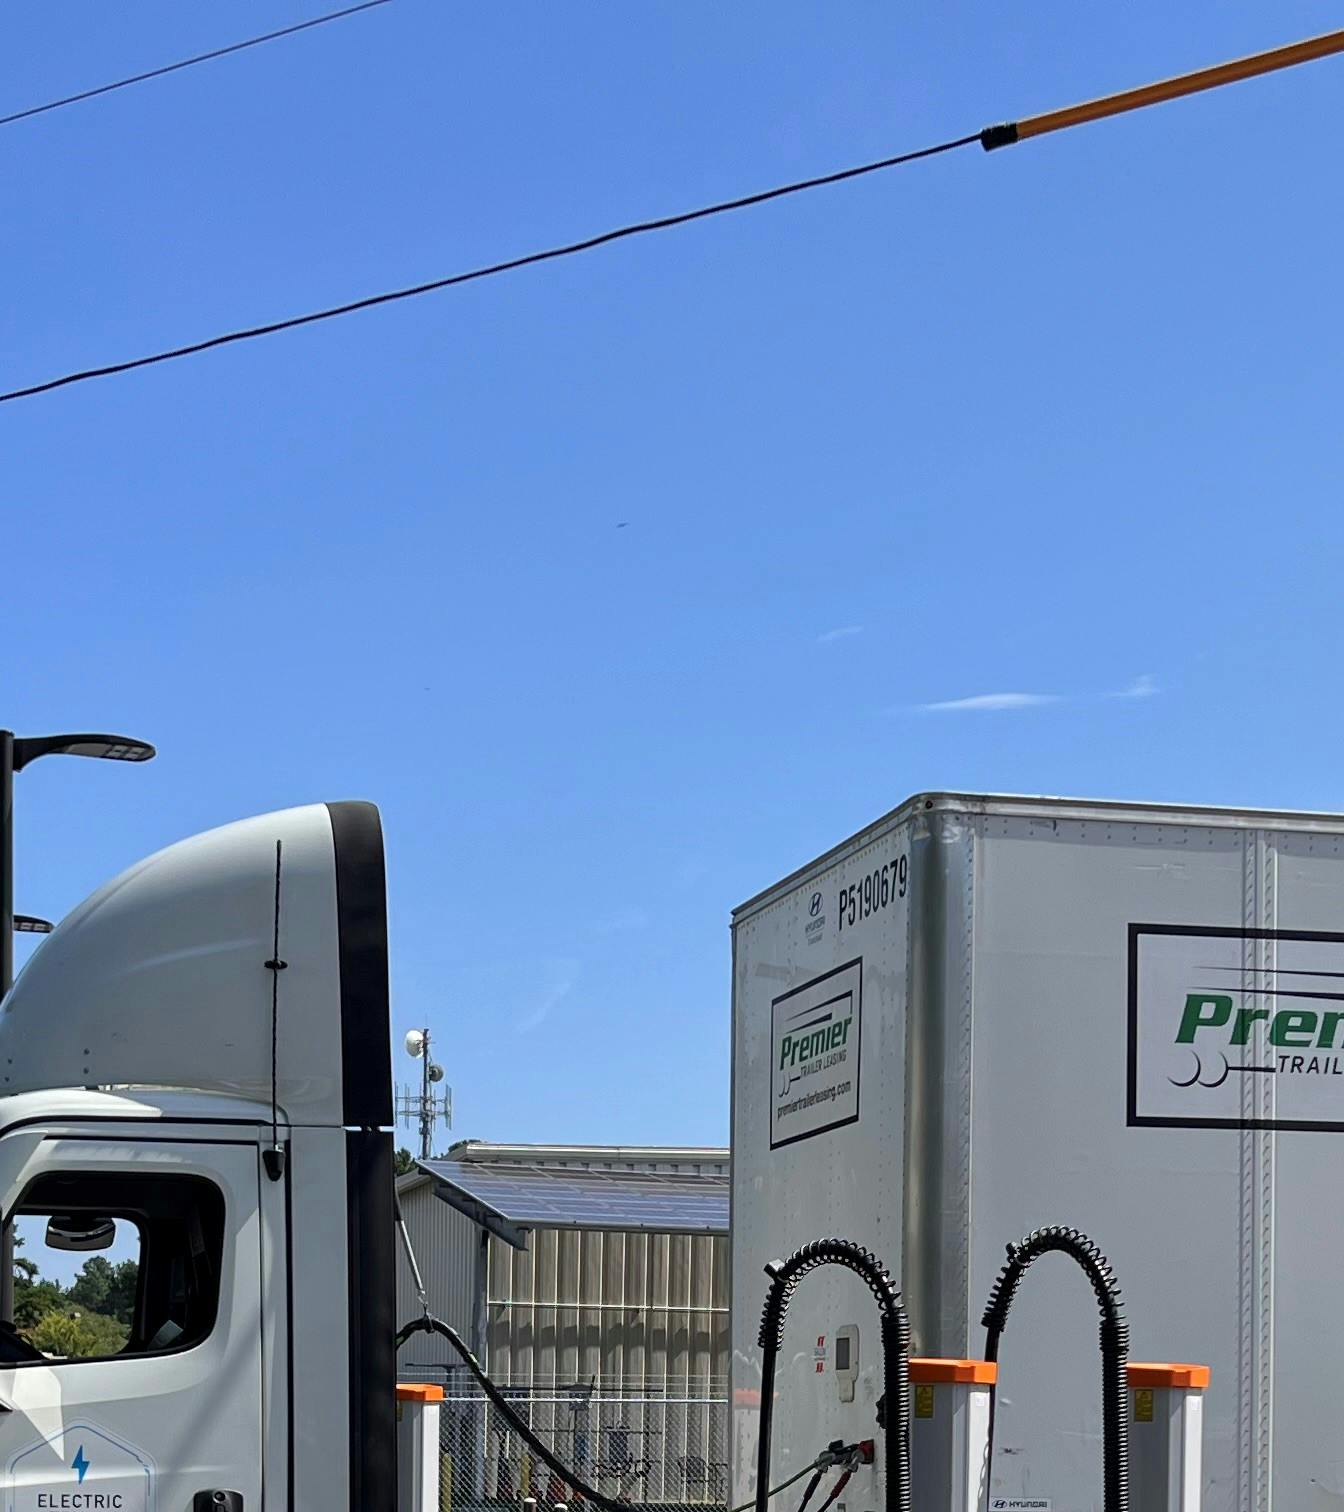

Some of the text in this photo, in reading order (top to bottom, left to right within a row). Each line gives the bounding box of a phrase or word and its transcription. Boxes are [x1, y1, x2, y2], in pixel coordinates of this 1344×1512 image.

[838, 854, 908, 931] P5190679
[779, 1016, 853, 1071] Premier
[800, 1049, 847, 1079] TRAILER LEASING
[37, 1493, 123, 1509] ELECTRIC
